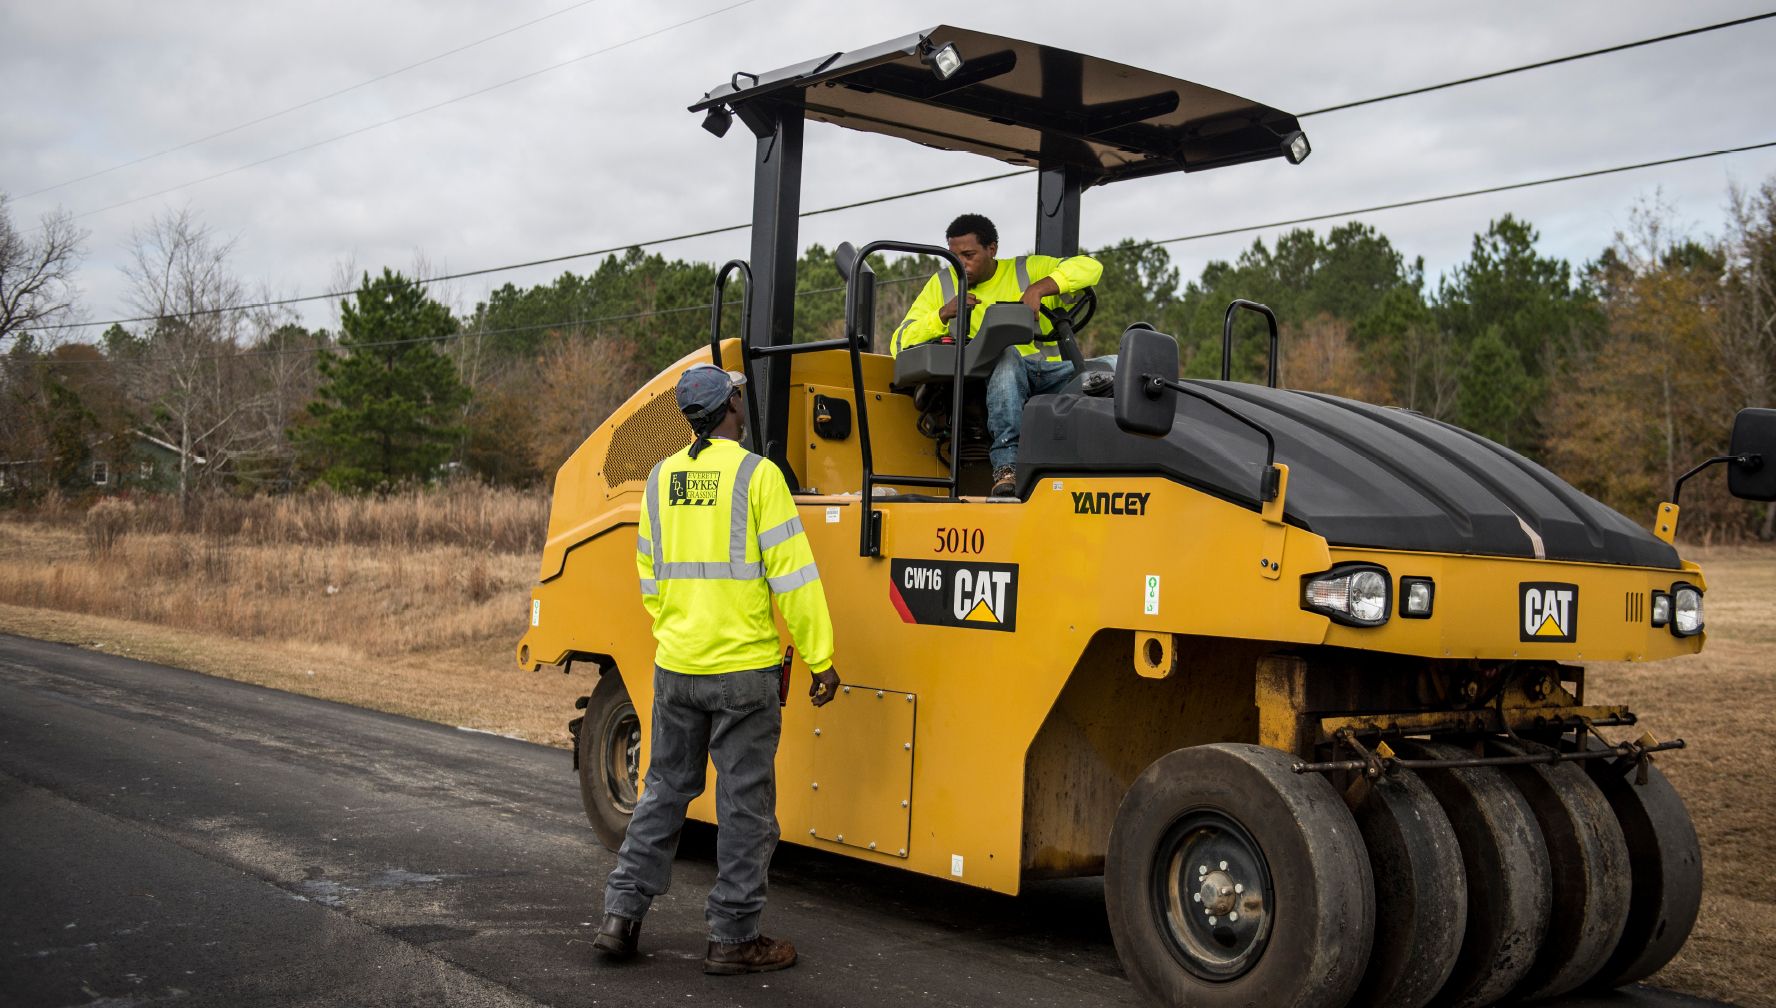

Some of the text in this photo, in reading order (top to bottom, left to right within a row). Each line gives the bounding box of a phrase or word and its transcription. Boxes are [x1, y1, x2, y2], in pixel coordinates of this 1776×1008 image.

[687, 480, 718, 490] DYKES
[1072, 491, 1151, 516] YANCEY
[933, 527, 985, 554] 5010
[904, 566, 942, 591] CW16
[953, 568, 1011, 624] CAT
[1525, 588, 1572, 636] CAT
